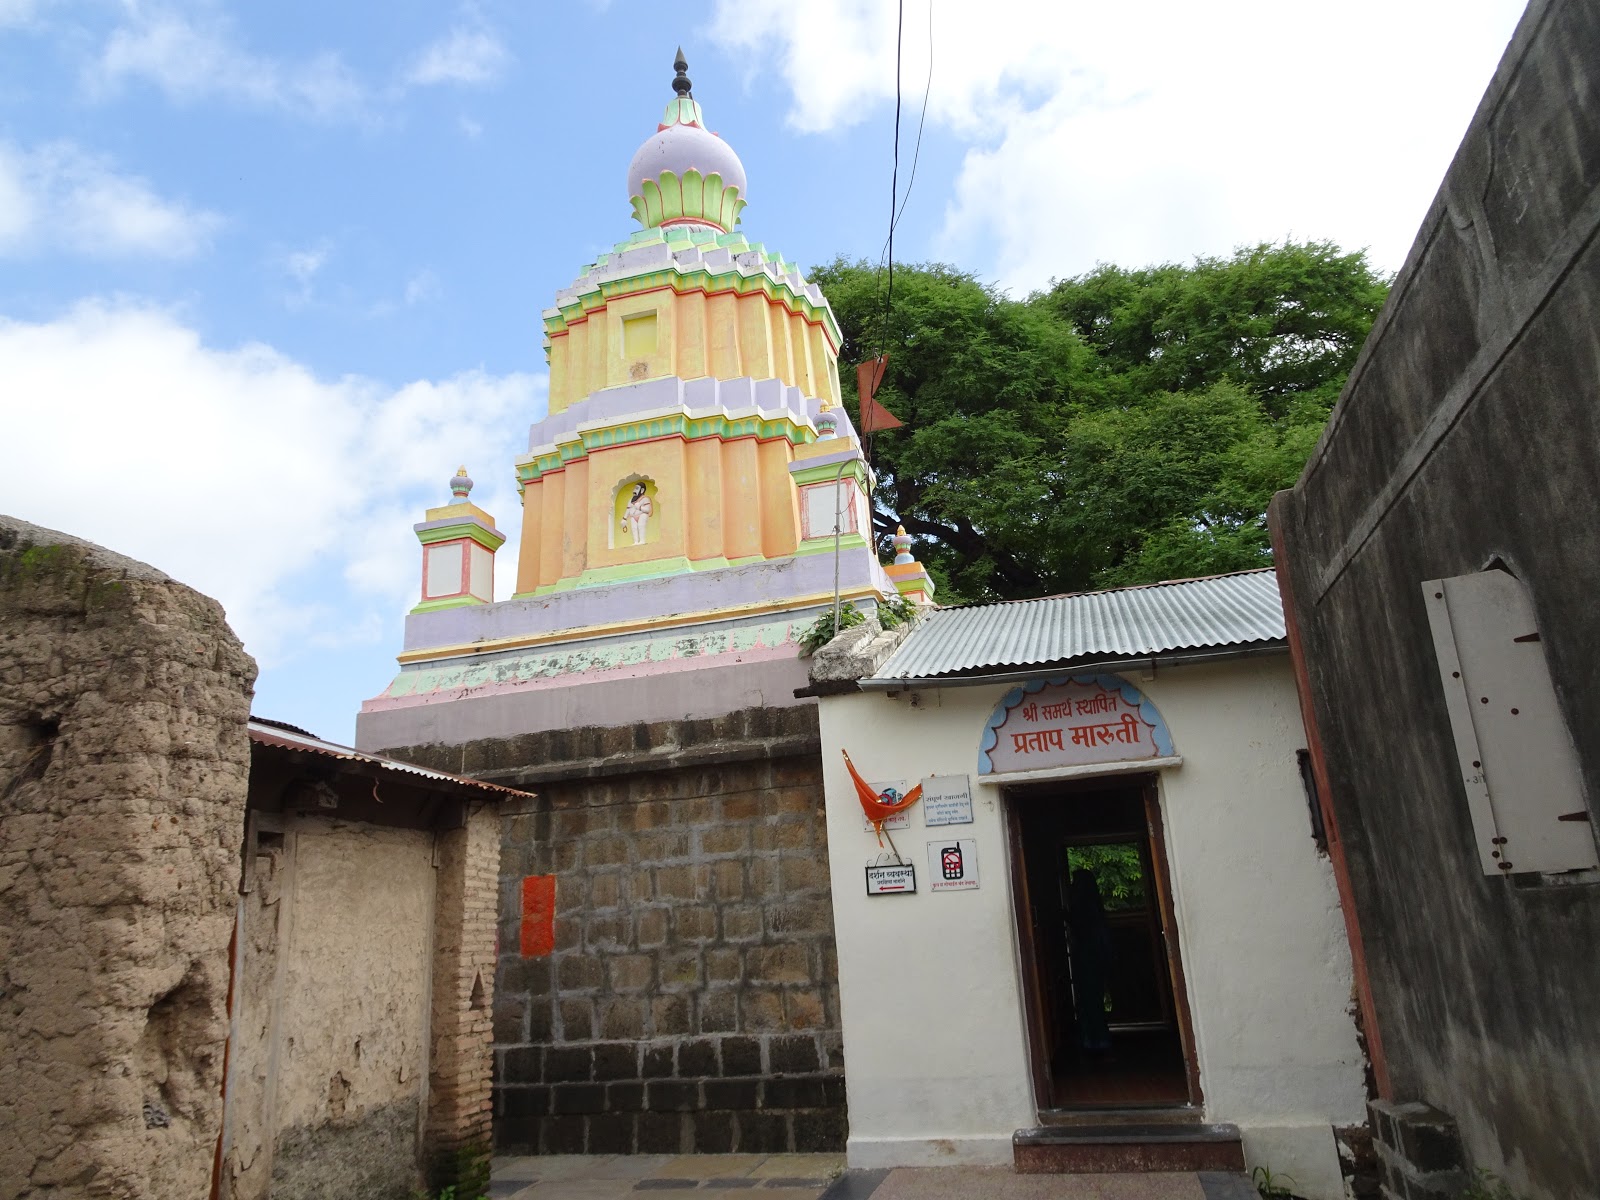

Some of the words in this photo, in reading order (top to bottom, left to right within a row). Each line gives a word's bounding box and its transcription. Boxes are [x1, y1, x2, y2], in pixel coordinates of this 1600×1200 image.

[1023, 702, 1038, 722] श्री
[1041, 697, 1072, 720] समर्थ
[1075, 693, 1117, 716] स्थापित
[1010, 728, 1065, 754] प्रताप
[1068, 712, 1140, 748] मारुती
